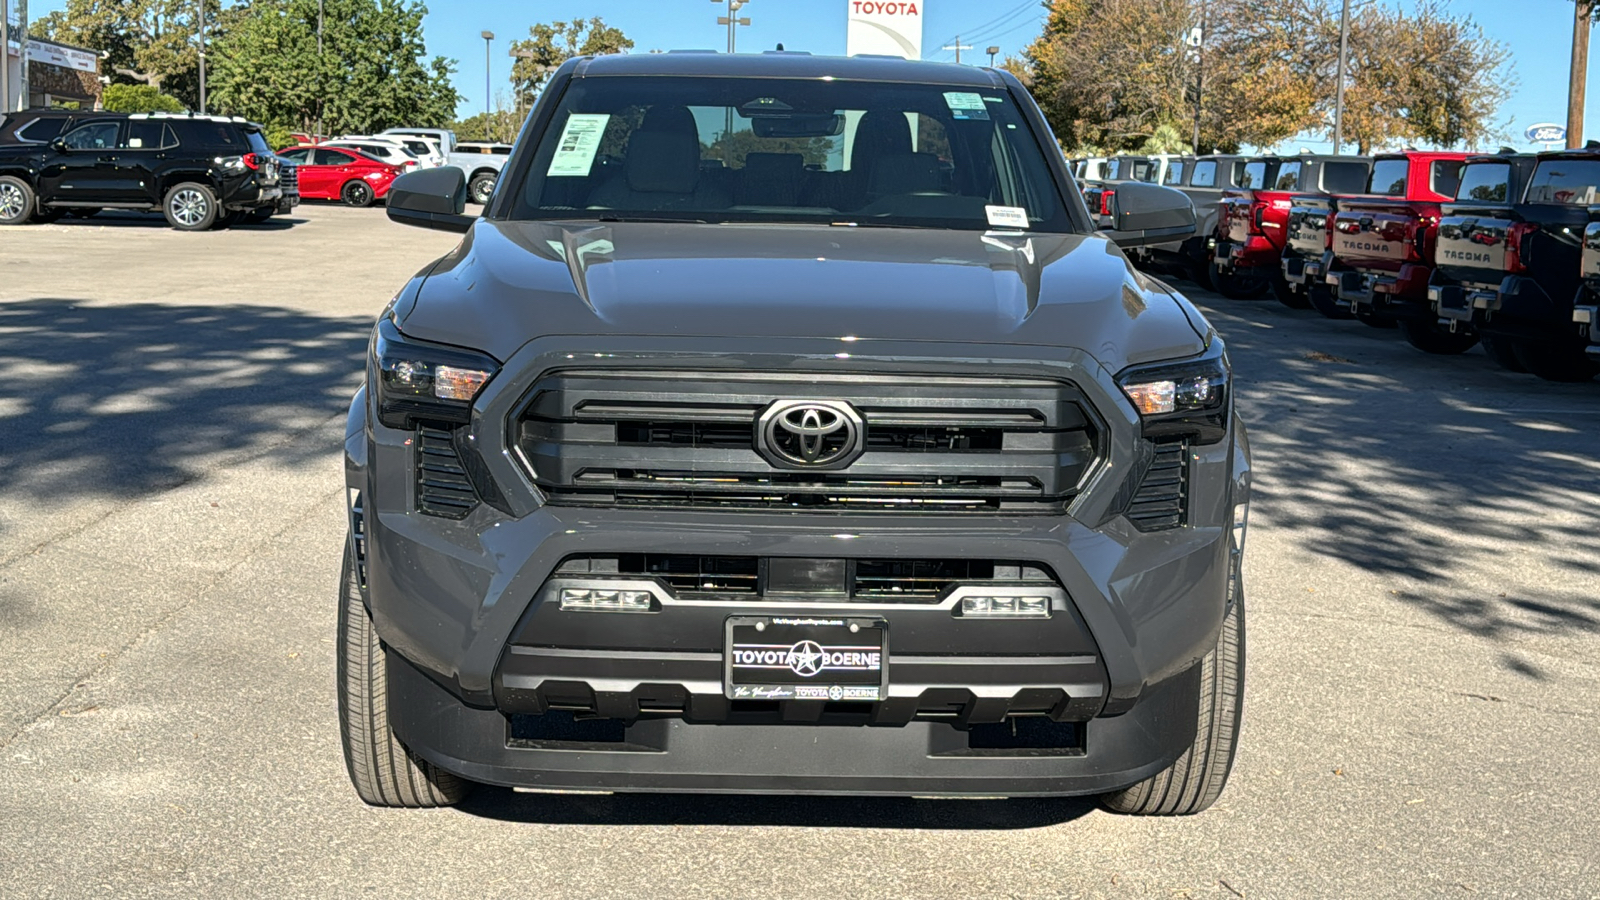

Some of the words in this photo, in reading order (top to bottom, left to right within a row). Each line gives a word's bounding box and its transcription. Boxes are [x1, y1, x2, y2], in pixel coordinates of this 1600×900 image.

[853, 1, 918, 16] TOYOTA
[1535, 128, 1563, 139] Ford
[1343, 240, 1389, 253] TACOMA
[1444, 250, 1491, 263] TACOMA
[733, 651, 796, 664] TOYOTA
[822, 652, 881, 666] BOERNE
[752, 687, 792, 697] Vaughan
[795, 688, 828, 697] TOYOTA
[843, 689, 879, 697] BOERNE
